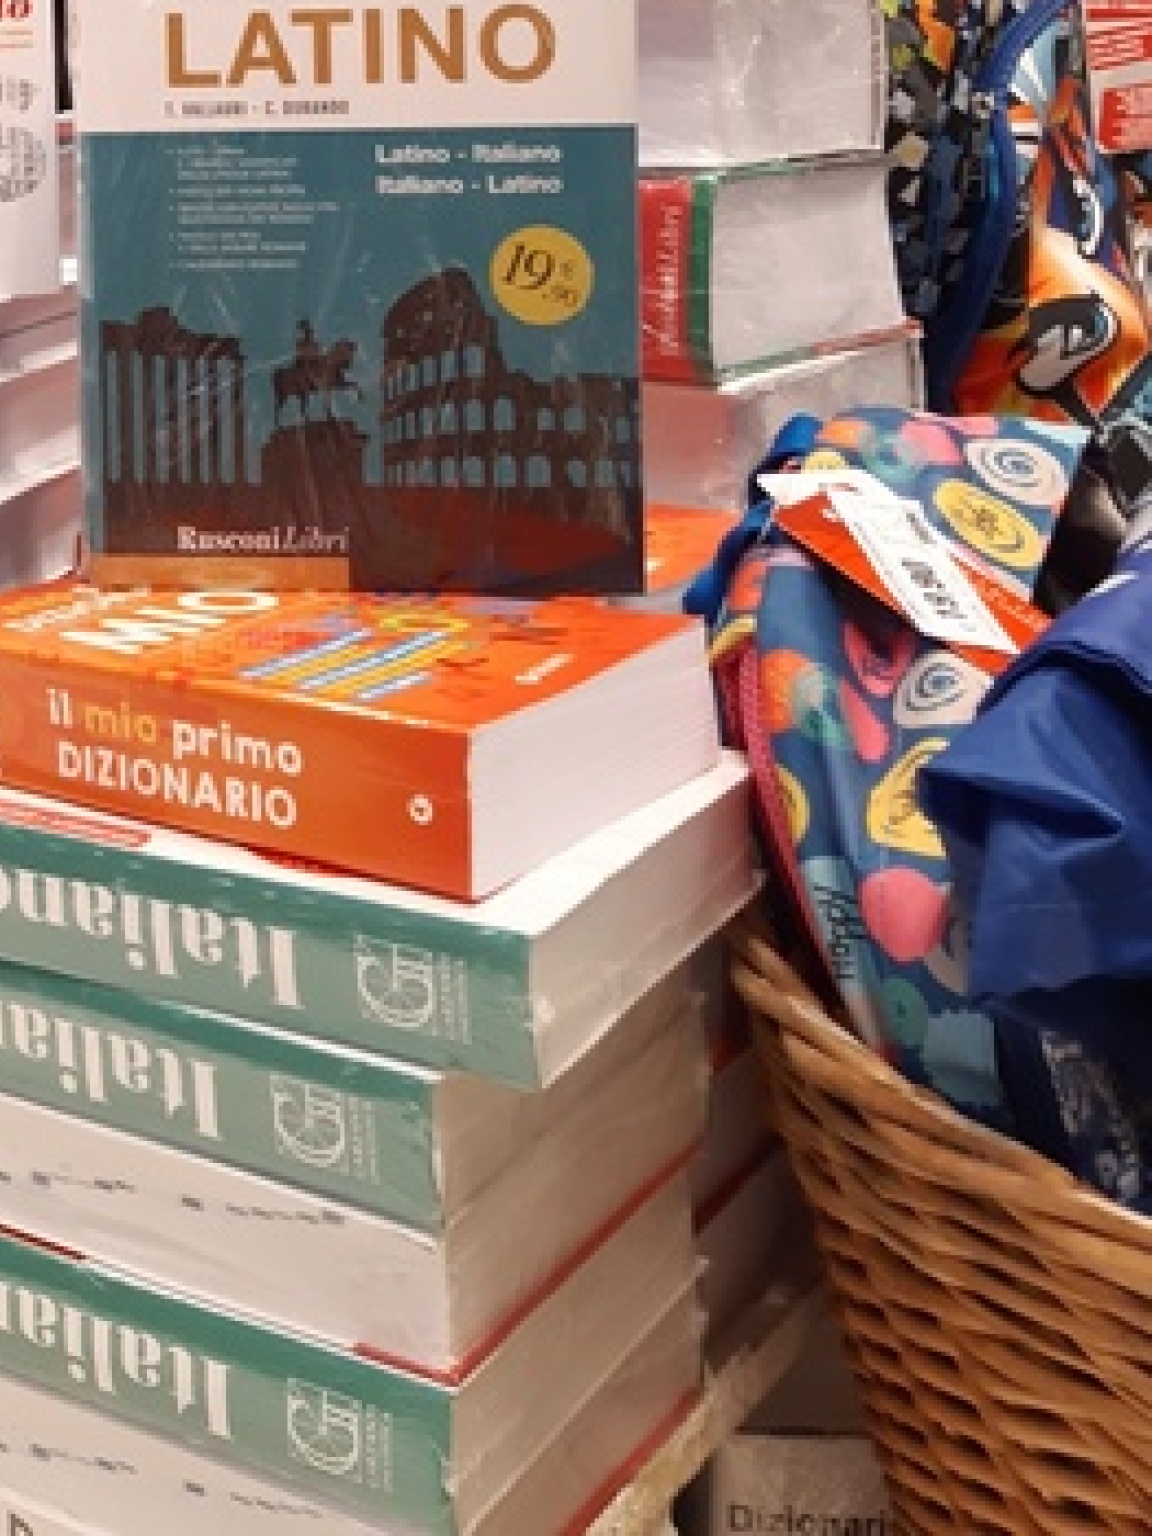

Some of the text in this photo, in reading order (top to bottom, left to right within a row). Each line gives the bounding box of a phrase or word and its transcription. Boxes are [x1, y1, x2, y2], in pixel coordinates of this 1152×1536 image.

[164, 2, 557, 89] LATINO
[375, 143, 450, 164] Latino
[471, 142, 562, 164] Italiano
[375, 174, 464, 195] Italiano
[486, 173, 563, 195] Latino
[503, 242, 556, 291] 19
[45, 686, 304, 779] il mio primo
[57, 742, 298, 827] DIZIONARIO
